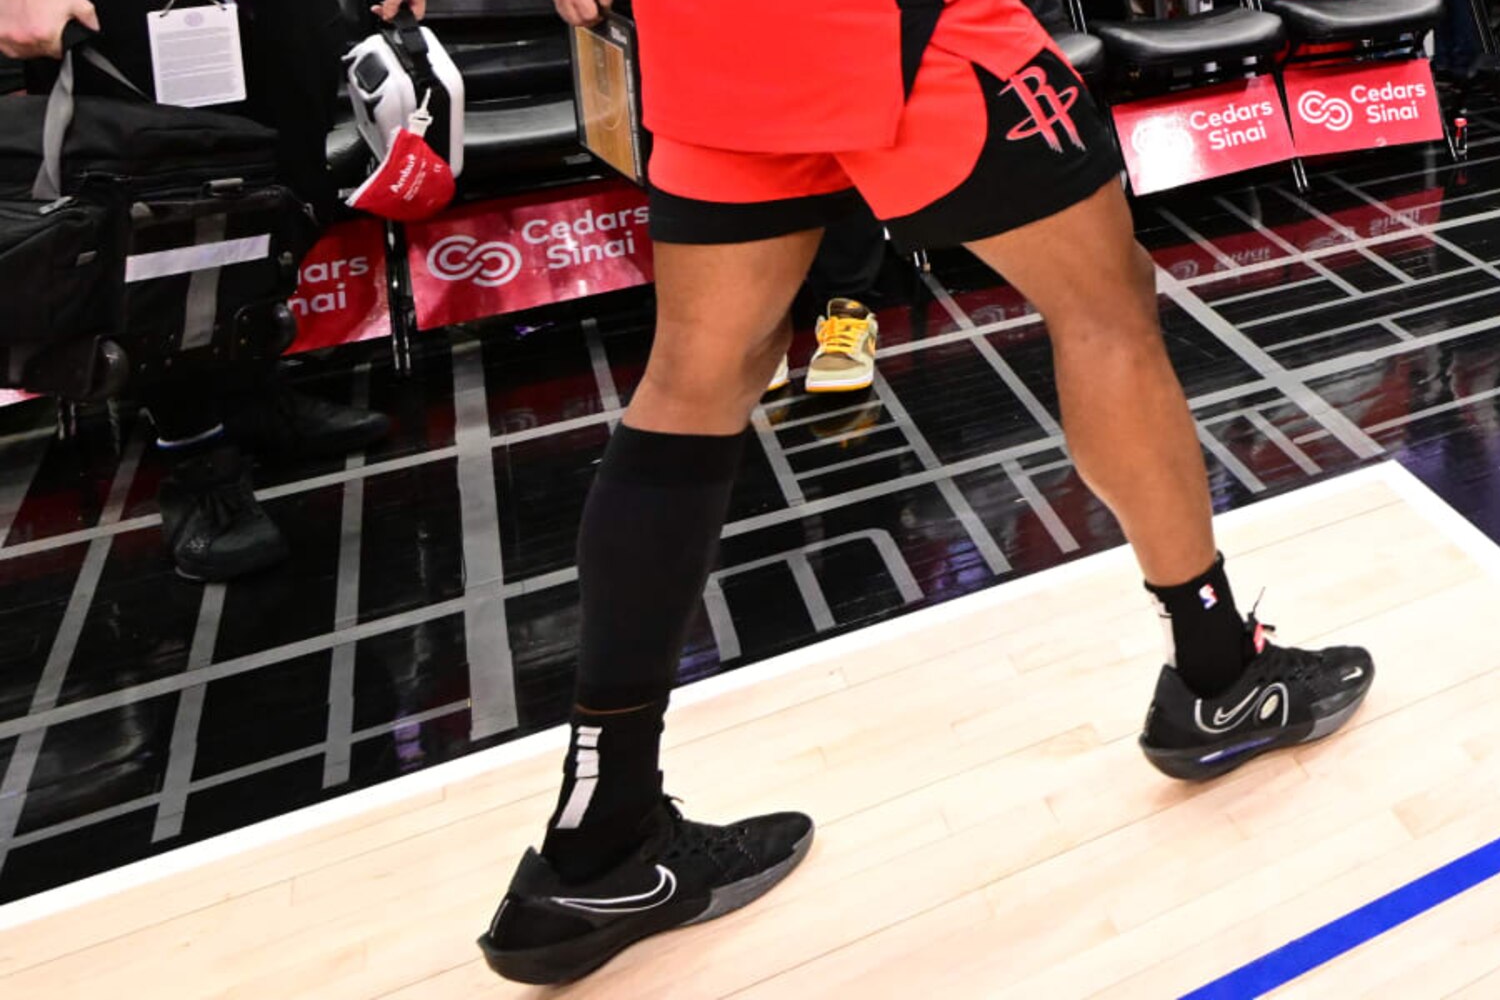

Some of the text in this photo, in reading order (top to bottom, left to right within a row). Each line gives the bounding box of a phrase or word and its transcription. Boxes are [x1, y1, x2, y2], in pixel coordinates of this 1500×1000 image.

[1350, 82, 1427, 103] Cedars
[1189, 100, 1274, 131] Cedars
[1366, 101, 1419, 124] Sinai
[1208, 121, 1268, 151] Sinai
[520, 205, 651, 244] Cedars
[546, 231, 635, 270] Sinai
